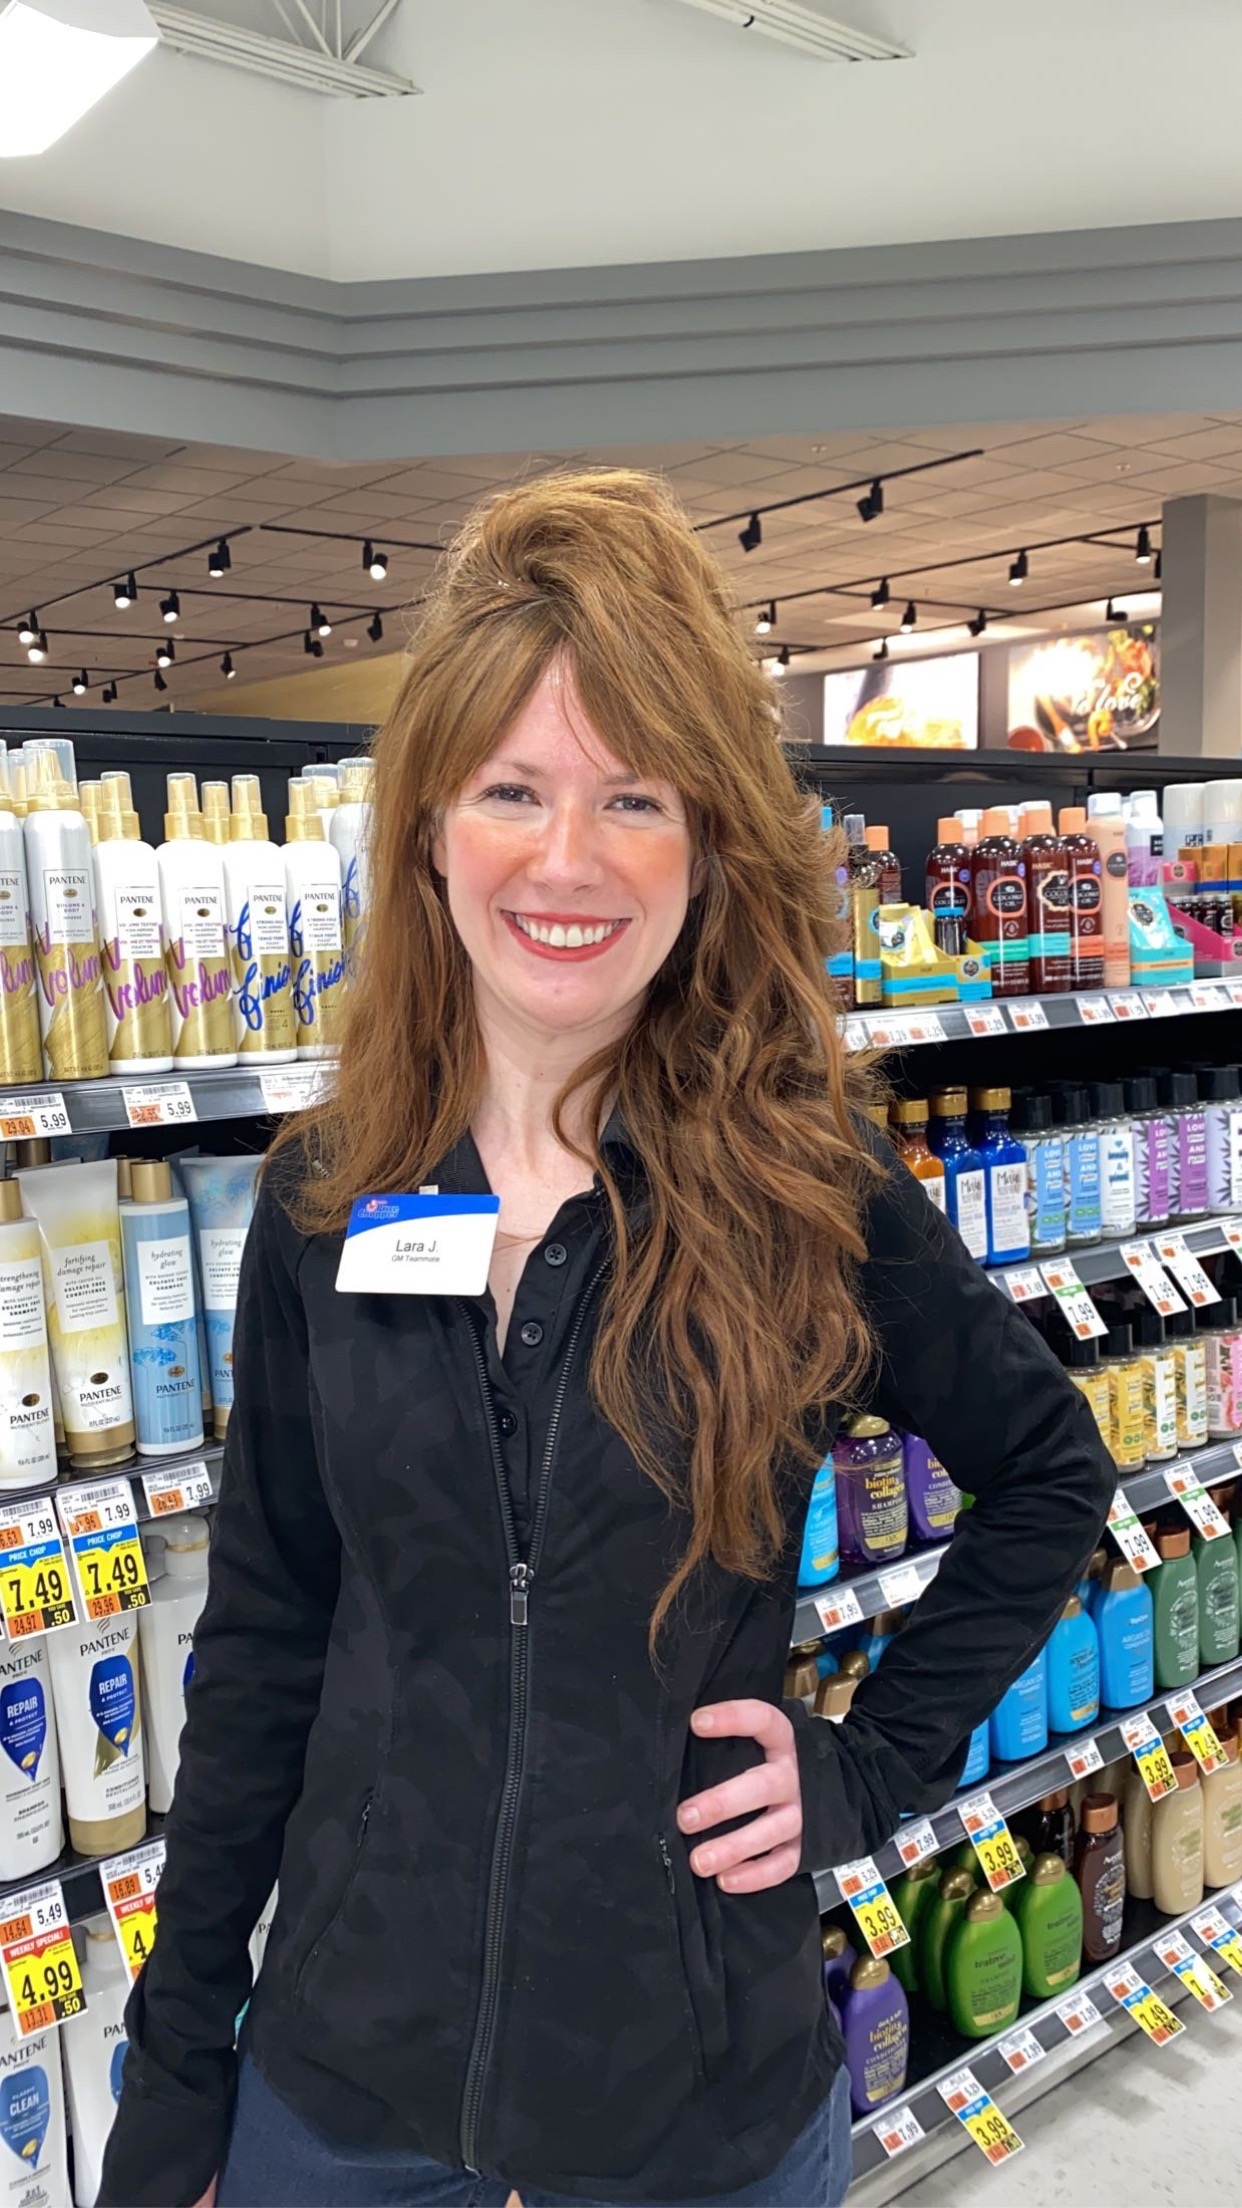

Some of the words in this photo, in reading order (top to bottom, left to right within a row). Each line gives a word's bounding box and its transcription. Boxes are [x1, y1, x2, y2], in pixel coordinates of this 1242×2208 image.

[49, 876, 86, 885] PANTENE
[120, 895, 154, 904] PANTENE
[185, 896, 218, 904] PANTENE
[253, 894, 283, 902] PANTENE
[304, 893, 336, 901] PANTENE
[993, 893, 1023, 901] COCONUT
[167, 1100, 192, 1116] 5.99
[4, 1119, 31, 1135] 29.04
[40, 1112, 67, 1129] 5.99
[211, 1239, 242, 1250] hydrating
[218, 1247, 234, 1257] glow
[396, 1240, 424, 1252] Lara
[428, 1240, 439, 1253] J.
[64, 1254, 96, 1267] fortifying
[151, 1248, 183, 1262] hydrating
[57, 1266, 84, 1277] damage
[85, 1261, 106, 1273] repair
[160, 1258, 176, 1270] glow
[64, 1284, 90, 1293] SULFATE
[1183, 1273, 1209, 1292] 7.99
[65, 1287, 107, 1299] CONDITIONER
[1149, 1282, 1175, 1301] 7.99
[2, 1302, 28, 1311] SULFATE
[9, 1307, 37, 1316] SHAMPOO
[1068, 1303, 1094, 1323] 7.99
[214, 1367, 233, 1378] PANT
[80, 1385, 122, 1402] PANTENE
[156, 1378, 195, 1394] PANTENE
[10, 1407, 49, 1424] PANTENE
[186, 1481, 210, 1500] 7.99
[865, 1476, 895, 1489] biotin
[105, 1503, 130, 1521] 7.99
[1194, 1504, 1220, 1525] 7.99
[28, 1518, 54, 1537] 7.99
[75, 1514, 97, 1532] 3.96
[87, 1535, 105, 1546] PRICE
[106, 1530, 123, 1541] CHOP
[1124, 1533, 1150, 1557] 7.99
[9, 1550, 27, 1562] PRICE
[29, 1546, 46, 1557] CHOP
[87, 1553, 139, 1595] 7.49
[9, 1569, 63, 1612] 7.49
[92, 1597, 115, 1617] 29.96
[127, 1592, 146, 1609] .50
[14, 1614, 37, 1635] 24.97
[51, 1609, 70, 1626] .50
[80, 1628, 130, 1656] PANTENE
[0, 1650, 43, 1677] ANTENE
[99, 1673, 127, 1695] REPAIR
[106, 1688, 128, 1701] PROTECT
[7, 1696, 39, 1718] REPAIR
[15, 1711, 38, 1725] PROTECT
[1145, 1757, 1169, 1784] 3.99
[18, 1800, 45, 1815] SHAMPOO
[984, 1842, 1013, 1872] 3.99
[113, 1878, 136, 1900] 16.89
[37, 1903, 62, 1925] 5.49
[120, 1899, 144, 1914] WEEKLY
[865, 1906, 897, 1937] 3.99
[3, 1920, 28, 1942] 14.64
[9, 1942, 35, 1958] WEEKLY
[36, 1931, 64, 1949] SPECIAL!
[22, 1961, 73, 2007] 4.99
[62, 1998, 81, 2018] .50
[24, 2006, 48, 2029] 13.31
[1139, 2004, 1169, 2031] 7.49
[0, 2035, 47, 2068] ANTENE
[9, 2092, 39, 2117] CLEAN
[899, 2121, 919, 2141] 7.99
[976, 2116, 1007, 2147] 3.99
